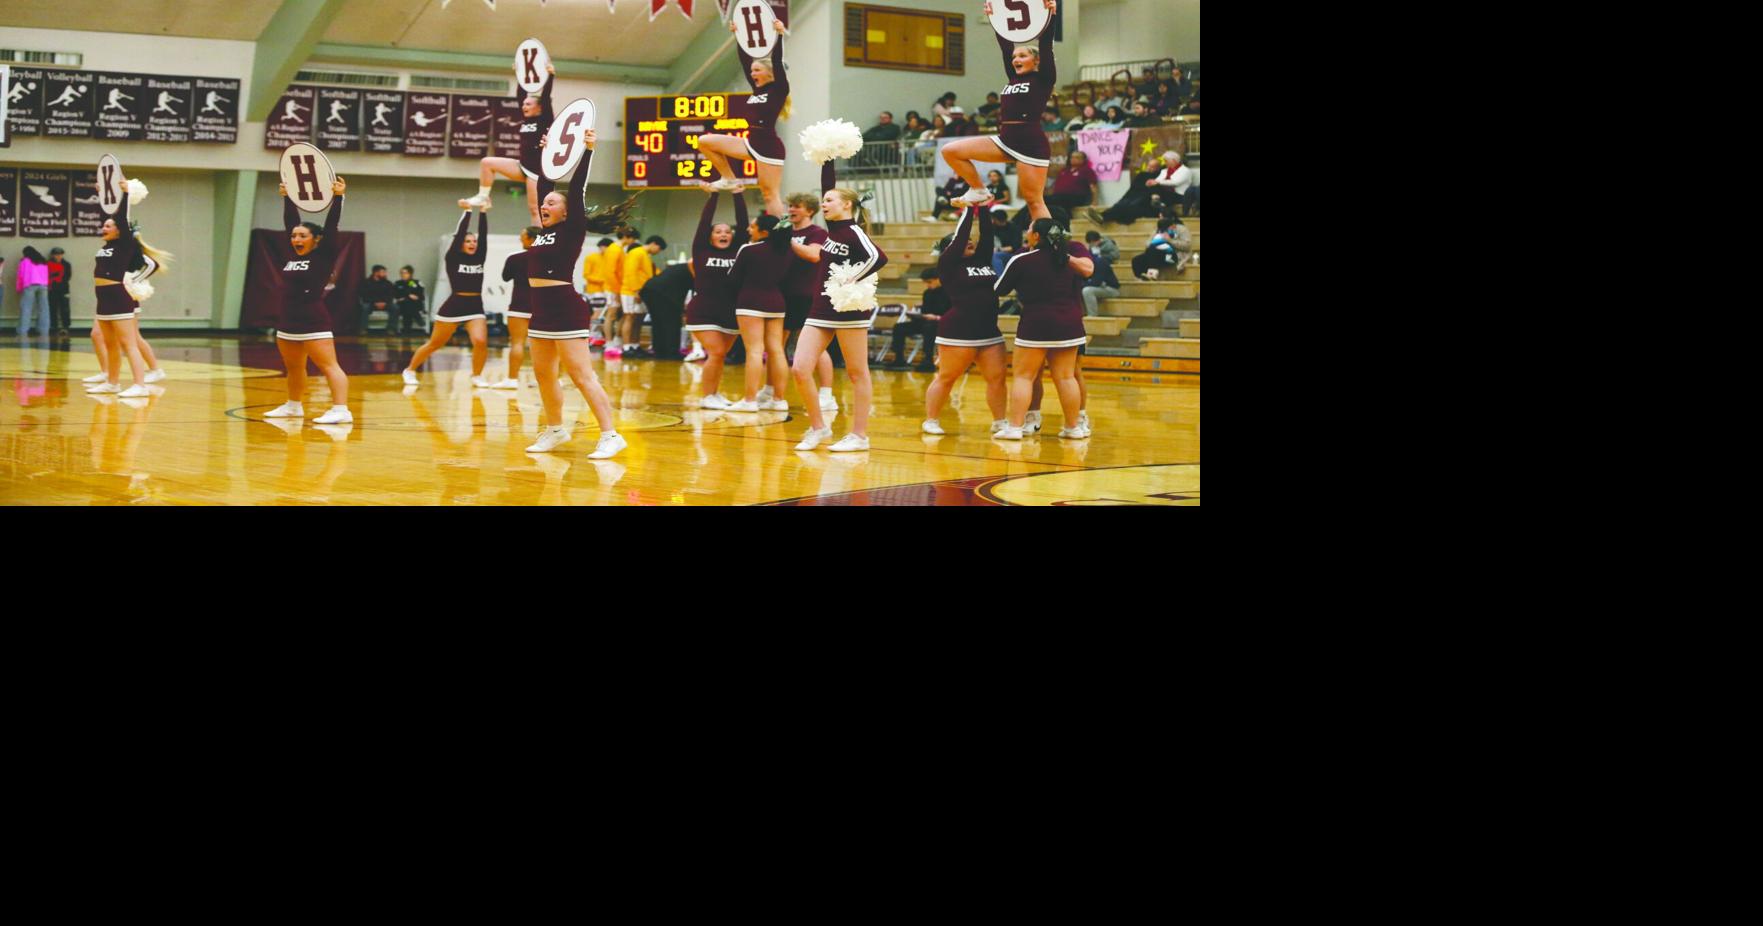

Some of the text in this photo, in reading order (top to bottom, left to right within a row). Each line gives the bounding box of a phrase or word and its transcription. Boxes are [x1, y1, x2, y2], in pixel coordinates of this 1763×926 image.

[1005, 0, 1030, 30] S
[741, 6, 767, 48] H
[522, 48, 540, 83] K
[47, 71, 93, 83] Volleyball
[99, 75, 142, 86] Baseball
[148, 79, 191, 90] Baseball
[196, 80, 238, 90] Baseball
[321, 90, 358, 99] Softball
[366, 93, 402, 102] Softball
[411, 95, 447, 105] Softball
[675, 96, 724, 118] 8:00
[52, 110, 77, 118] Region
[99, 113, 129, 121] Region
[45, 118, 92, 127] Champions
[95, 120, 141, 130] Champions
[149, 116, 178, 125] Region
[196, 116, 225, 124] Region
[144, 123, 190, 133] Champions
[192, 123, 237, 133] Champions
[552, 112, 584, 167] S
[635, 133, 699, 153] 40 4
[1081, 132, 1112, 144] DANCE
[1097, 144, 1123, 156] YOUR
[634, 161, 646, 178] 0
[700, 160, 713, 177] 2
[743, 160, 756, 177] 0
[290, 155, 323, 200] H
[102, 164, 117, 205] K
